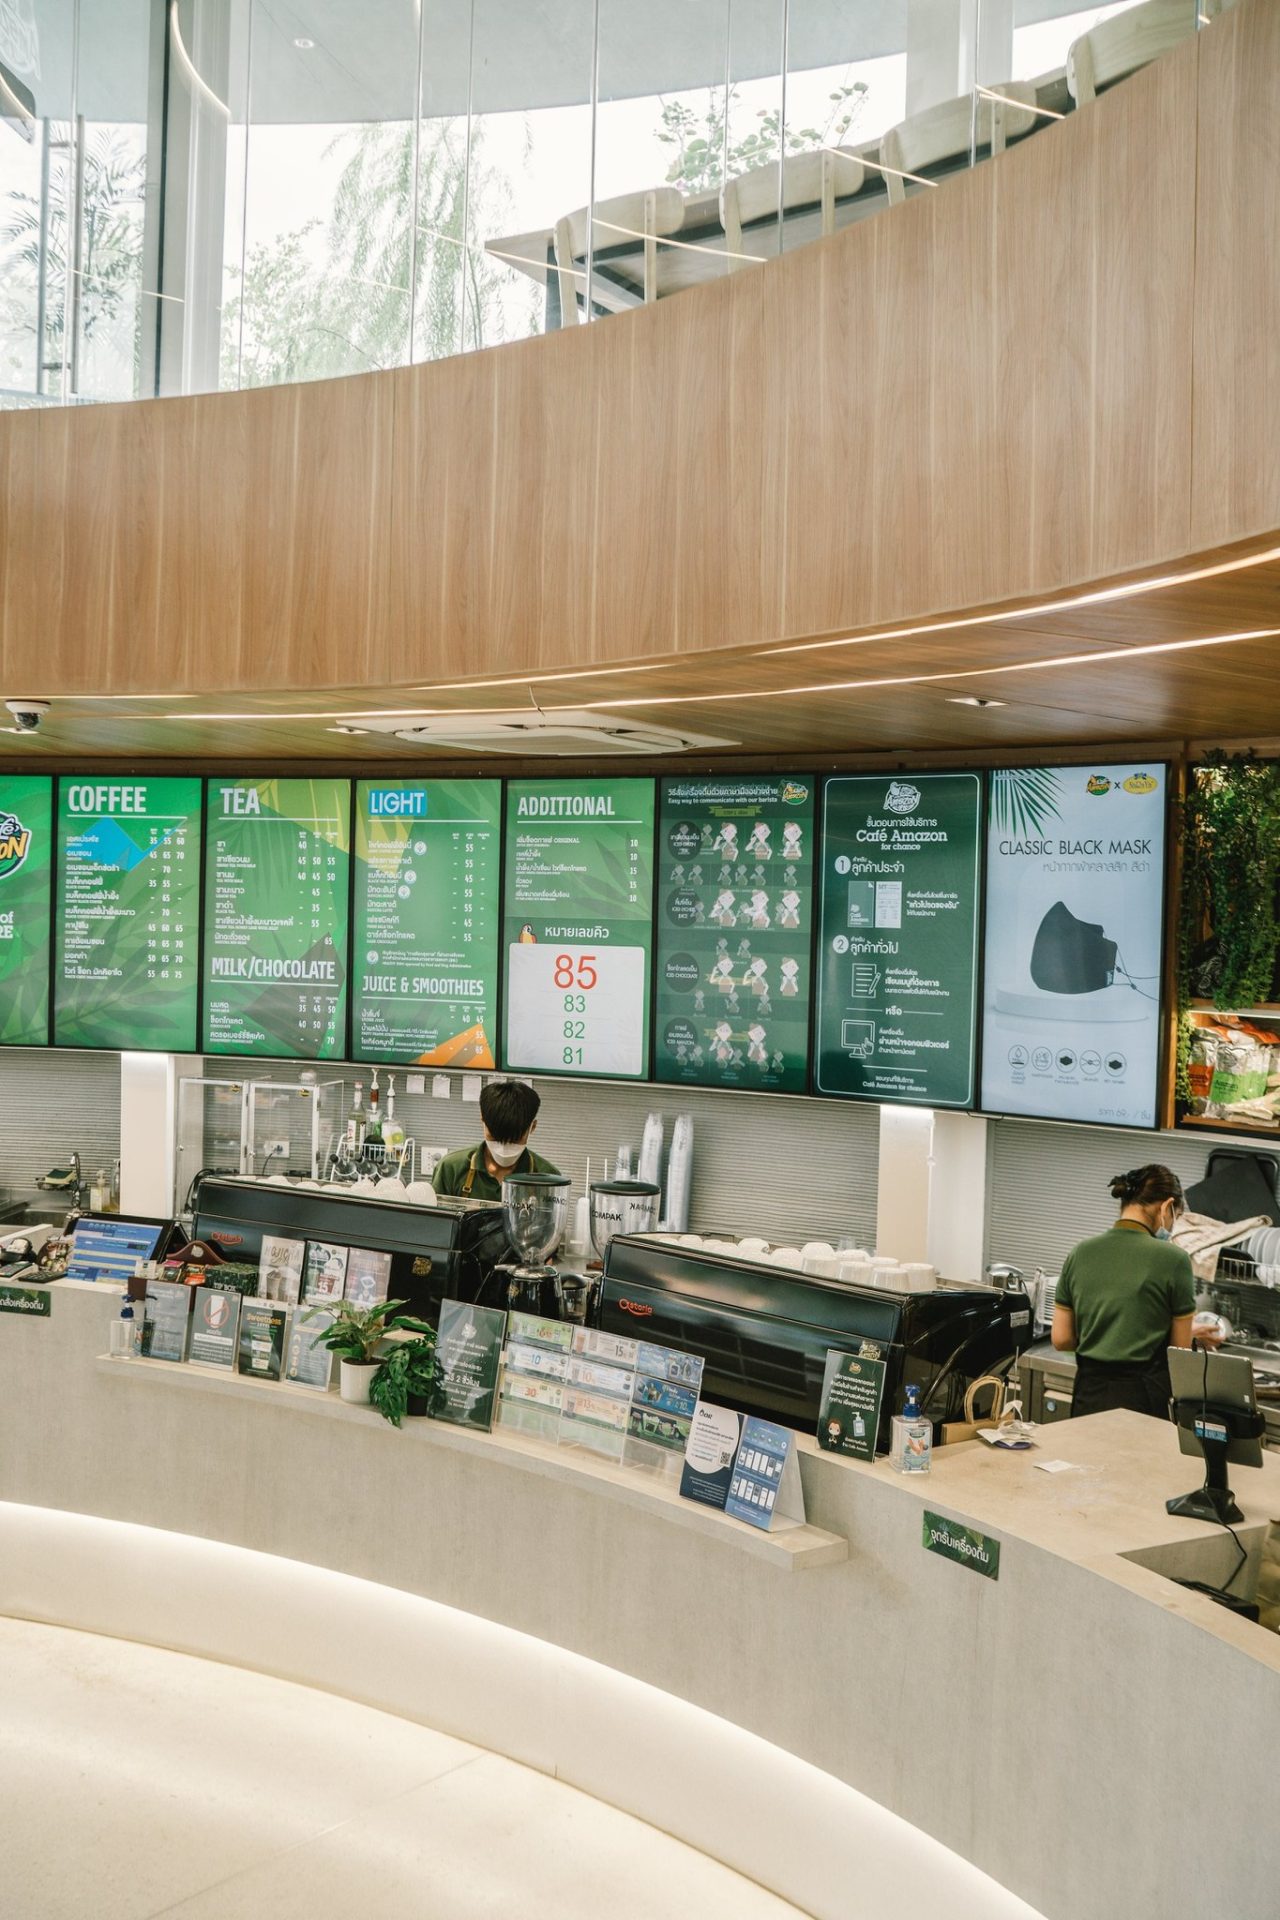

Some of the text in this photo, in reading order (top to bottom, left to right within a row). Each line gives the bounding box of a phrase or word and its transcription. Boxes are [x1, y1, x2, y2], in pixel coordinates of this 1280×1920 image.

[69, 786, 147, 812] COFFEE
[220, 788, 260, 814] TEA
[371, 792, 424, 814] LIGHT
[518, 796, 615, 815] ADDITIONAL
[866, 816, 937, 827] ขั้นตอนการใช้บริการ
[856, 828, 948, 842] Café Amazon
[150, 837, 157, 845] 35
[299, 841, 307, 849] 40
[465, 844, 473, 852] 55
[999, 840, 1151, 855] CLASSIC BLACK MASK
[313, 857, 321, 865] 50
[327, 857, 335, 865] 55
[465, 860, 473, 868] 55
[630, 867, 637, 875] 15
[852, 860, 904, 875] ลูกค้าประจำ
[1132, 862, 1150, 872] สีดำ
[298, 872, 306, 880] 40
[313, 872, 320, 880] 45
[312, 888, 320, 896] 45
[464, 889, 472, 897] 55
[162, 894, 170, 902] 65
[216, 901, 320, 912] ชาดำ 35
[464, 904, 472, 912] 55
[161, 924, 170, 932] 60
[175, 924, 183, 932] 65
[464, 919, 472, 927] 45
[545, 926, 609, 938] หมายเลขคิว
[464, 934, 472, 942] 55
[175, 940, 183, 948] 70
[838, 939, 843, 949] 2
[851, 938, 899, 955] ลูกค้าทั่วไป
[161, 955, 169, 963] 65
[175, 955, 183, 963] 70
[212, 956, 335, 979] MILK/CHOCOLATE
[554, 954, 597, 989] 85
[161, 970, 169, 978] 65
[362, 976, 484, 996] JUICE & SMOOTHIES
[885, 976, 939, 988] เขียนเมนูที่ต้องการ
[564, 994, 586, 1013] 83
[313, 1005, 321, 1013] 45
[328, 1006, 336, 1014] 50
[885, 1005, 902, 1015] หรือ
[299, 1020, 306, 1028] 40
[313, 1021, 321, 1029] 50
[462, 1015, 484, 1024] 40 45
[475, 1031, 484, 1039] 55
[563, 1021, 585, 1039] 82
[475, 1046, 483, 1054] 65
[563, 1047, 582, 1064] 81
[592, 1210, 622, 1221] COMPAK
[318, 1281, 328, 1293] 15
[615, 1344, 624, 1356] 15
[531, 1354, 541, 1365] 10
[526, 1387, 537, 1397] 30
[931, 1529, 989, 1562] จุดรับเครื่องดื่ม
